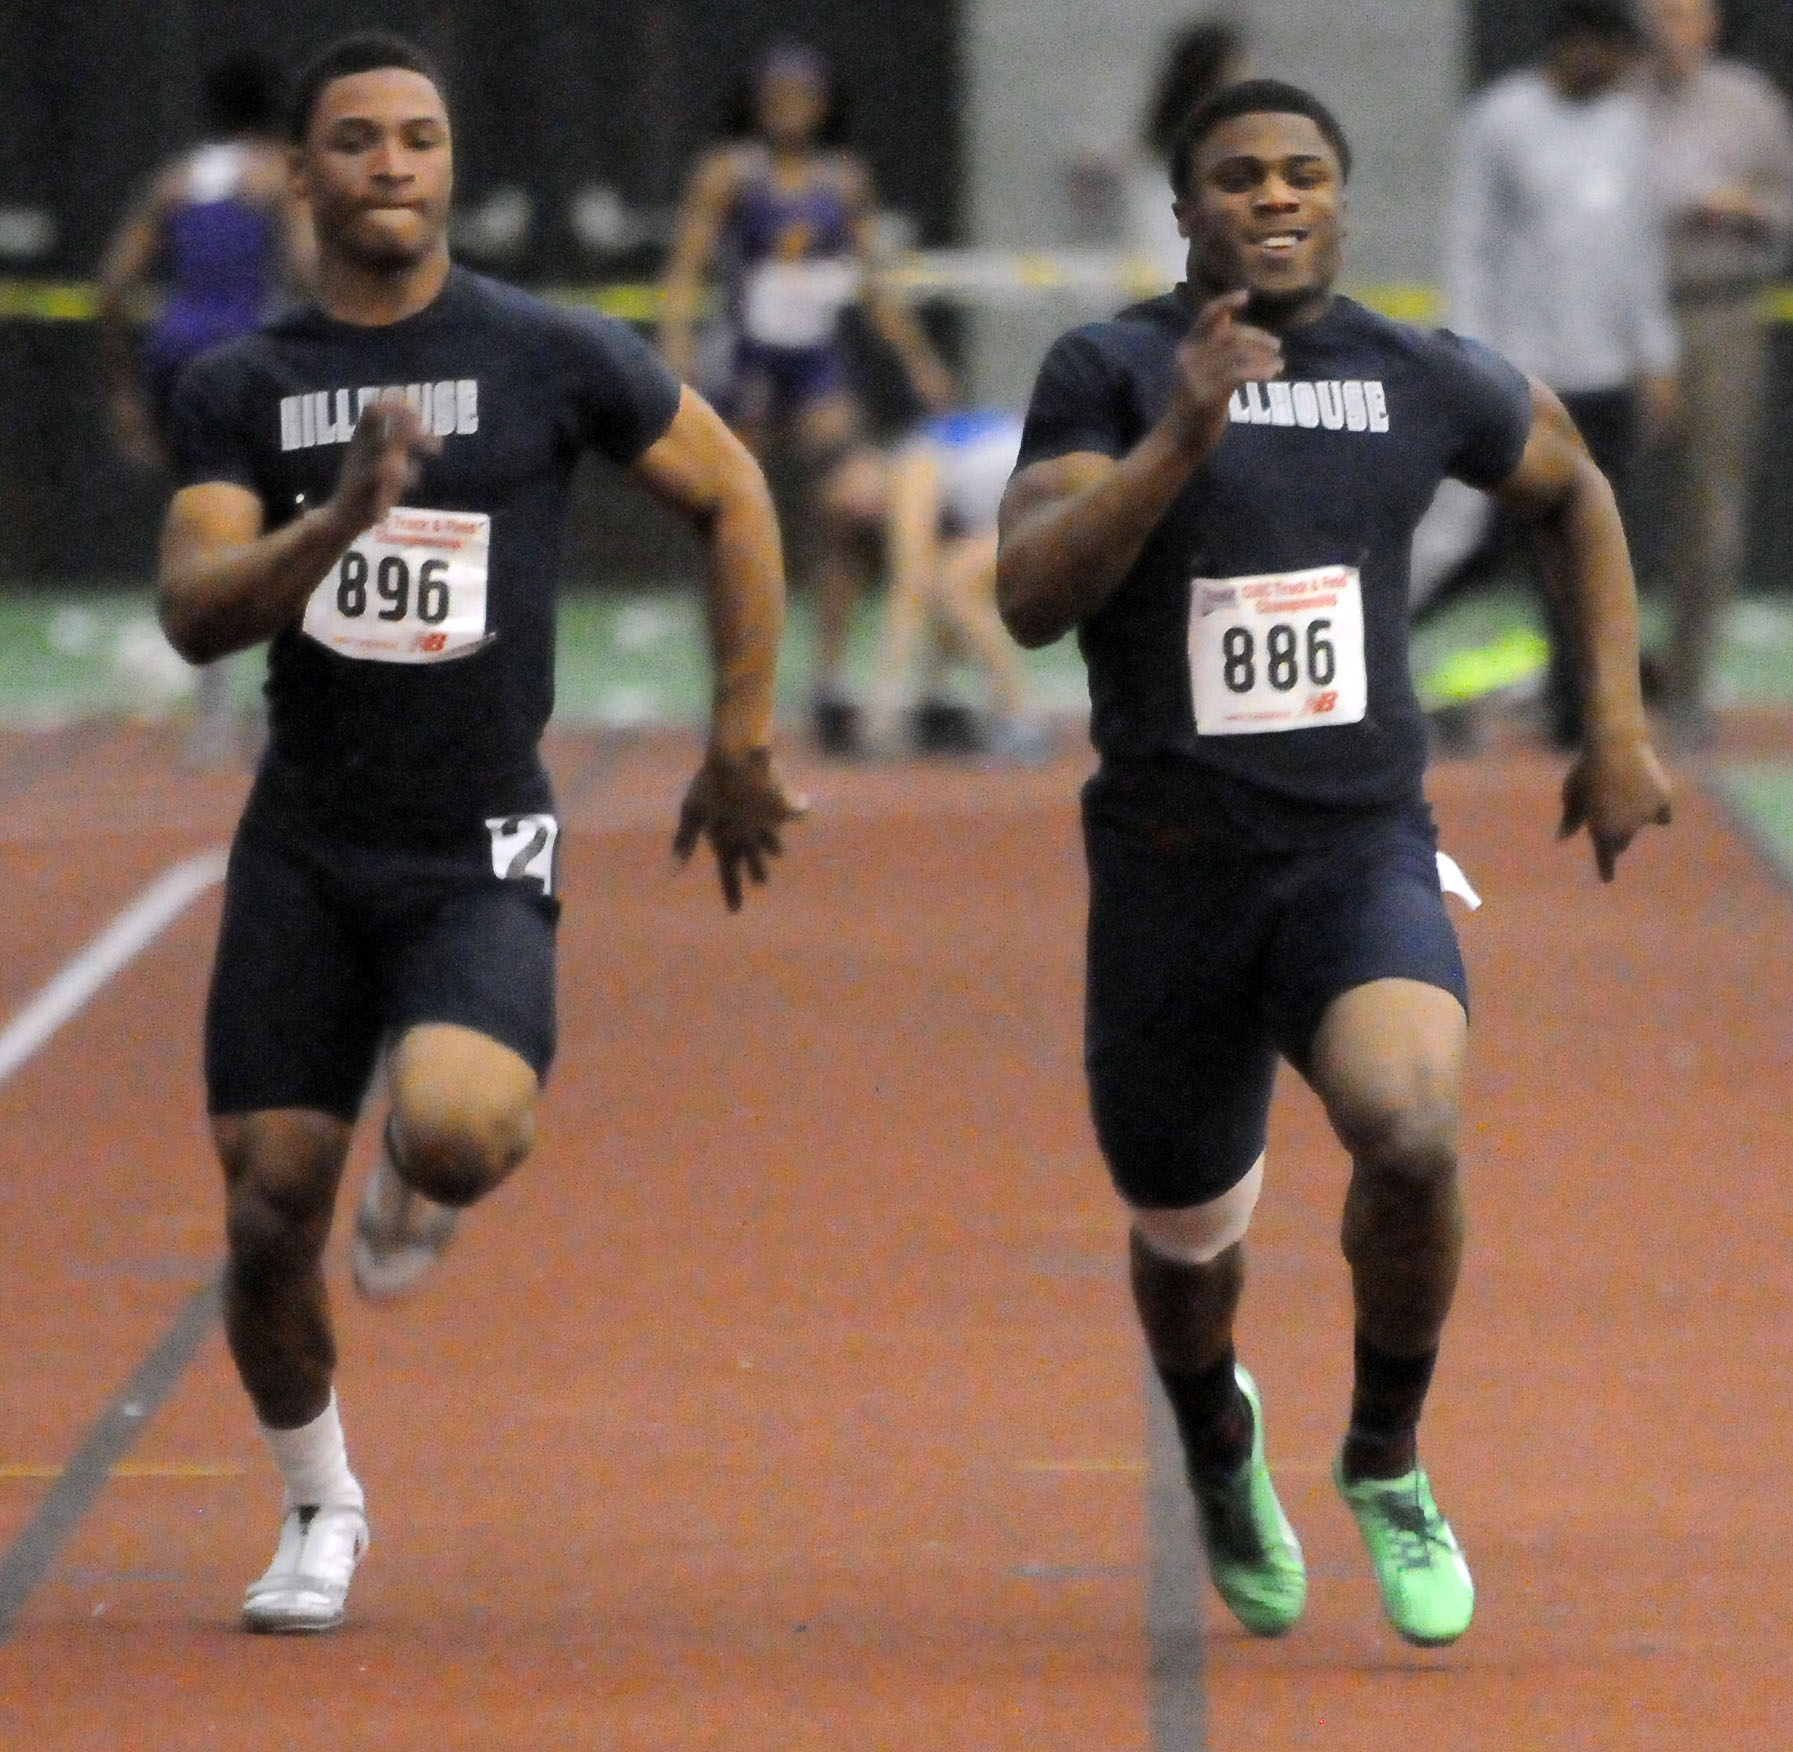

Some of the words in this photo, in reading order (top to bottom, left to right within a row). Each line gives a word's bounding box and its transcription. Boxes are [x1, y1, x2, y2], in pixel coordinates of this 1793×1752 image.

[280, 379, 479, 451] HILLUSE
[1229, 380, 1390, 433] LLHOUSE
[336, 551, 450, 624] 896
[1223, 619, 1336, 693] 886
